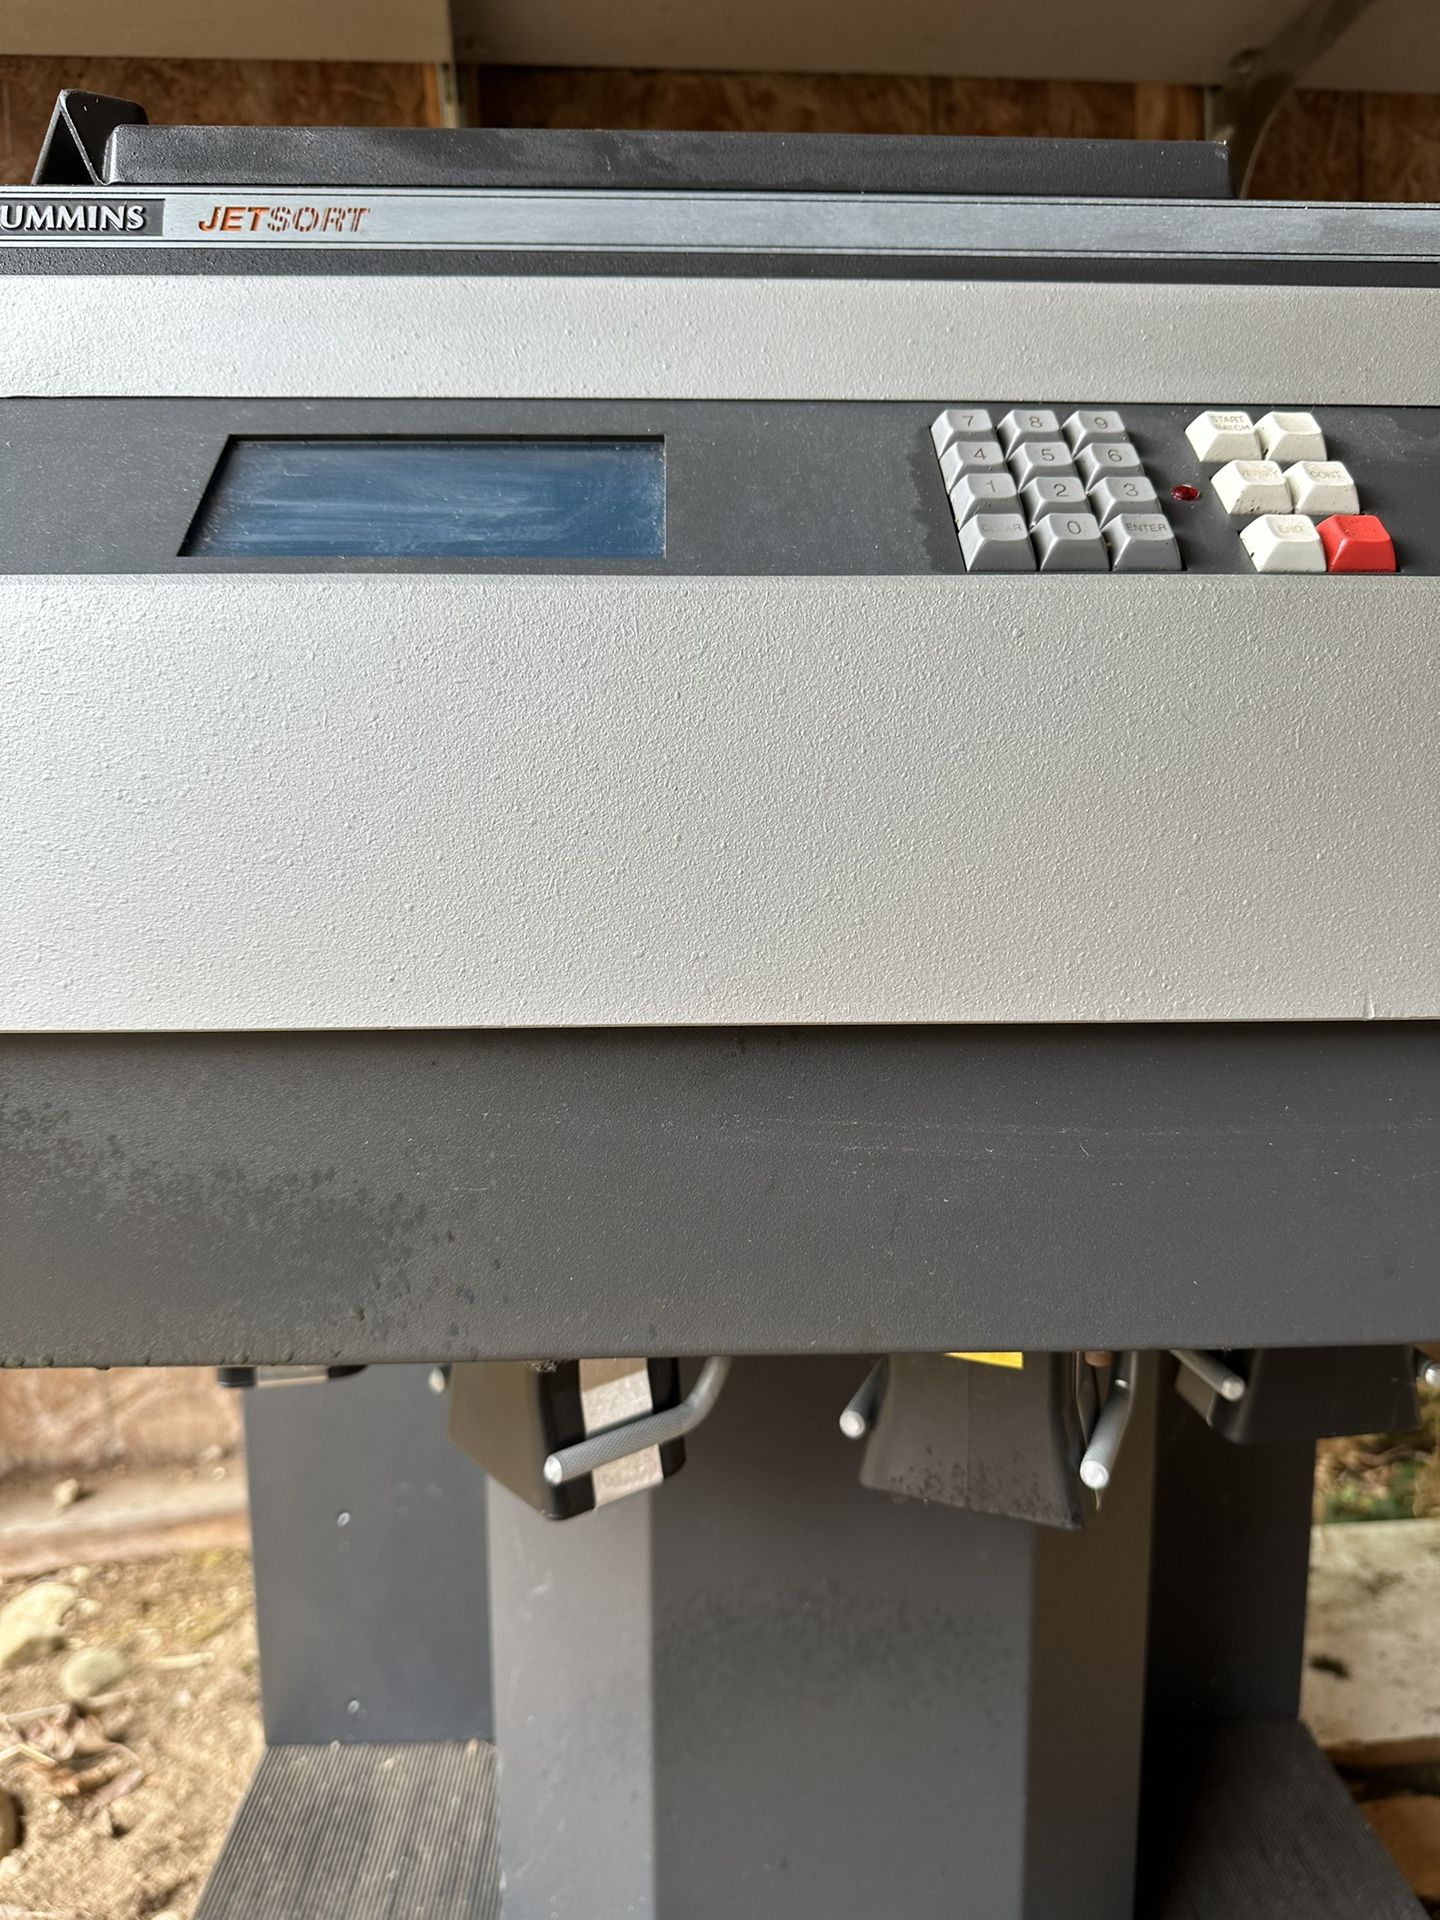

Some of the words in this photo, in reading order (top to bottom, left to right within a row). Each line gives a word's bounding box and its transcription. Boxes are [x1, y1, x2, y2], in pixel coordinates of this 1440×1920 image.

[0, 204, 146, 231] UMMINS
[198, 206, 370, 232] JETSORT
[962, 415, 974, 427] 7
[1029, 416, 1043, 428] 8
[1094, 417, 1108, 429] 9
[973, 448, 986, 460] 4
[1041, 449, 1055, 461] 5
[1107, 449, 1122, 462] 6
[986, 480, 996, 493] 1
[1053, 484, 1069, 497] 2
[1123, 483, 1139, 496] 3
[1125, 522, 1167, 532] ENTER
